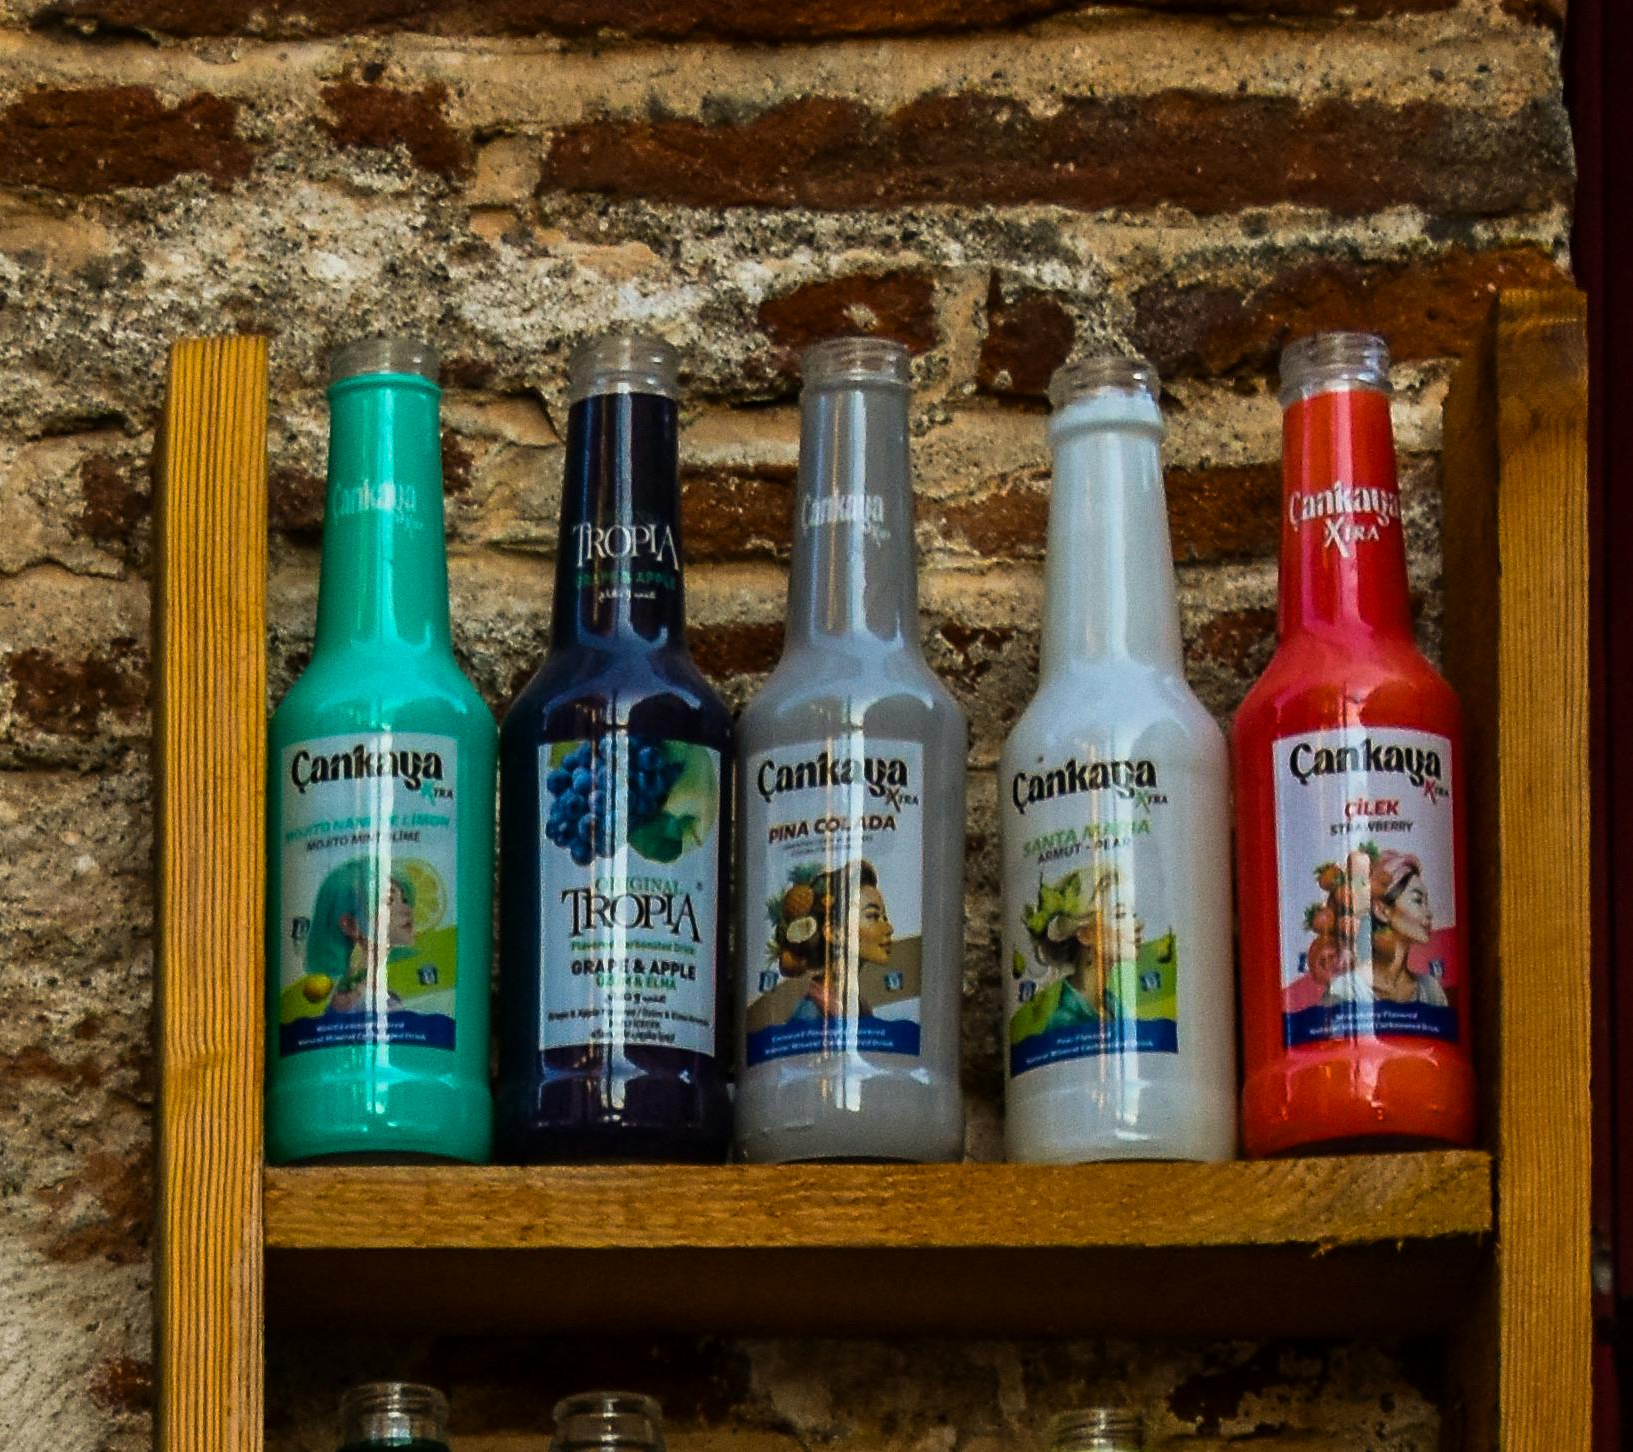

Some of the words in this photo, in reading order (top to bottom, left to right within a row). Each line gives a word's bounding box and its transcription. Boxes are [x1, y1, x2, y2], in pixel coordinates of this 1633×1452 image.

[1289, 479, 1399, 532] Çankaya
[573, 521, 680, 572] TROPIA
[1324, 516, 1380, 558] XTRA
[291, 744, 443, 794] Çankaya
[758, 752, 908, 804] Çankaya
[1012, 758, 1158, 815] Çankaya
[1289, 737, 1442, 787] Çankaya
[768, 820, 809, 845] PINA
[1344, 797, 1400, 821] ÇİLEK
[1023, 827, 1078, 858] SANTA
[561, 886, 701, 943] TROPIA
[632, 957, 645, 974] &
[649, 958, 696, 981] APPLE
